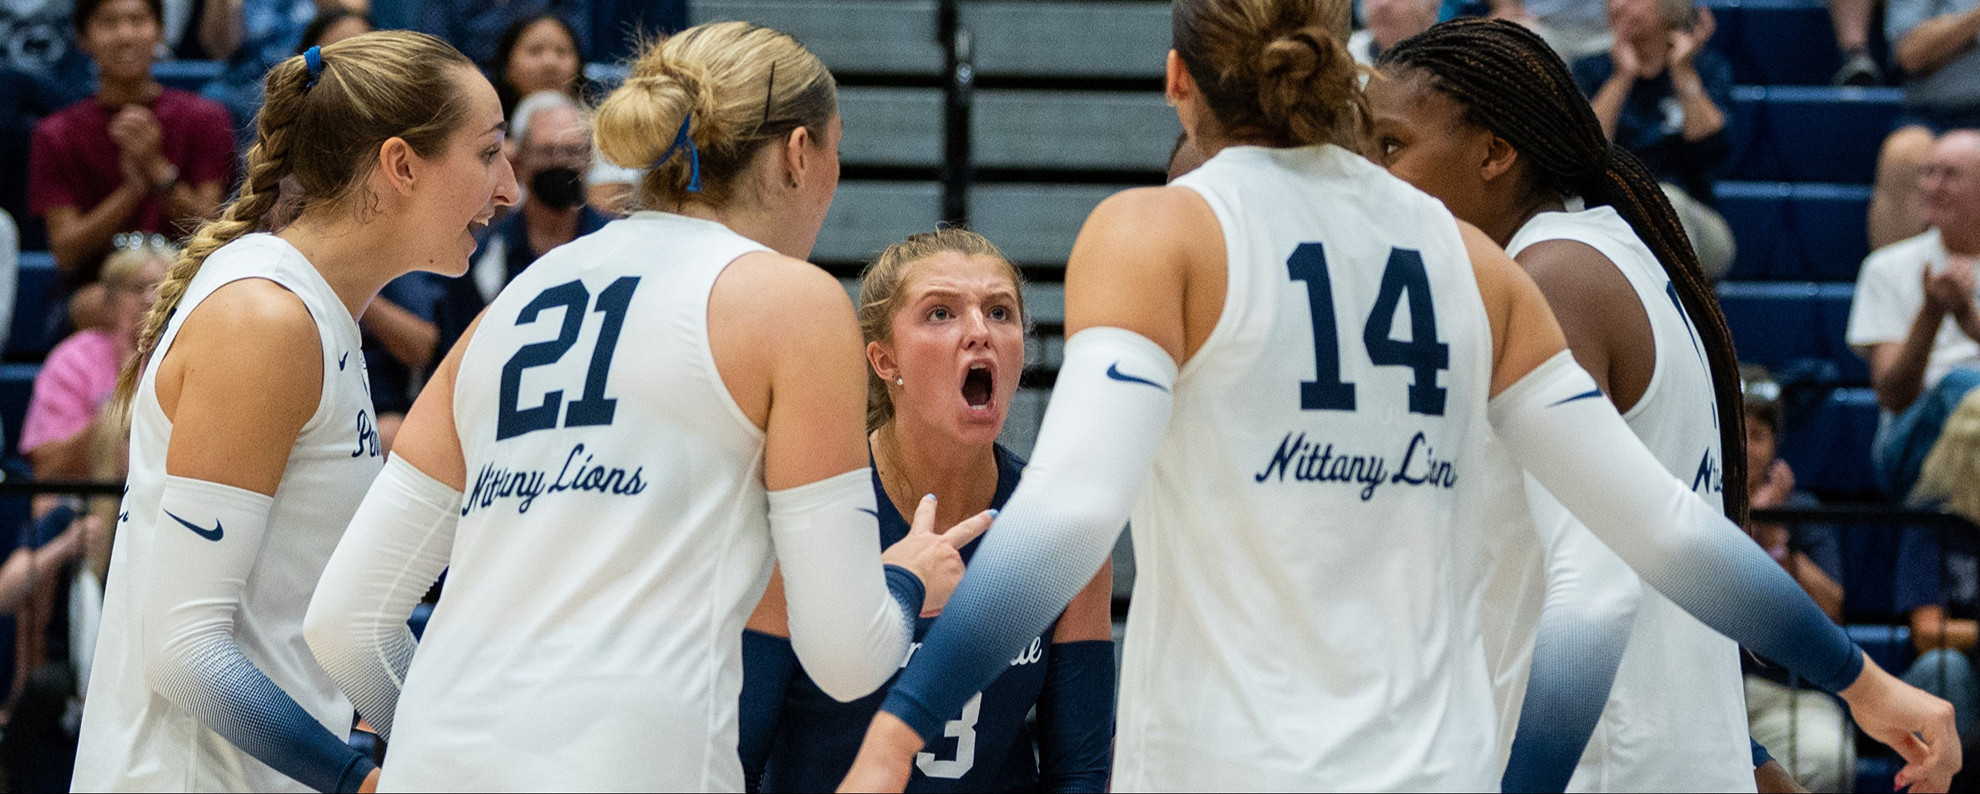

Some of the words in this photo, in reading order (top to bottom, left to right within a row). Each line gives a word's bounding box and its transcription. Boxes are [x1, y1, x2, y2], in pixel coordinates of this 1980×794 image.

[496, 275, 642, 441] 21
[1286, 242, 1449, 417] 14
[547, 442, 647, 496] Lions
[1255, 431, 1388, 502] Nittany
